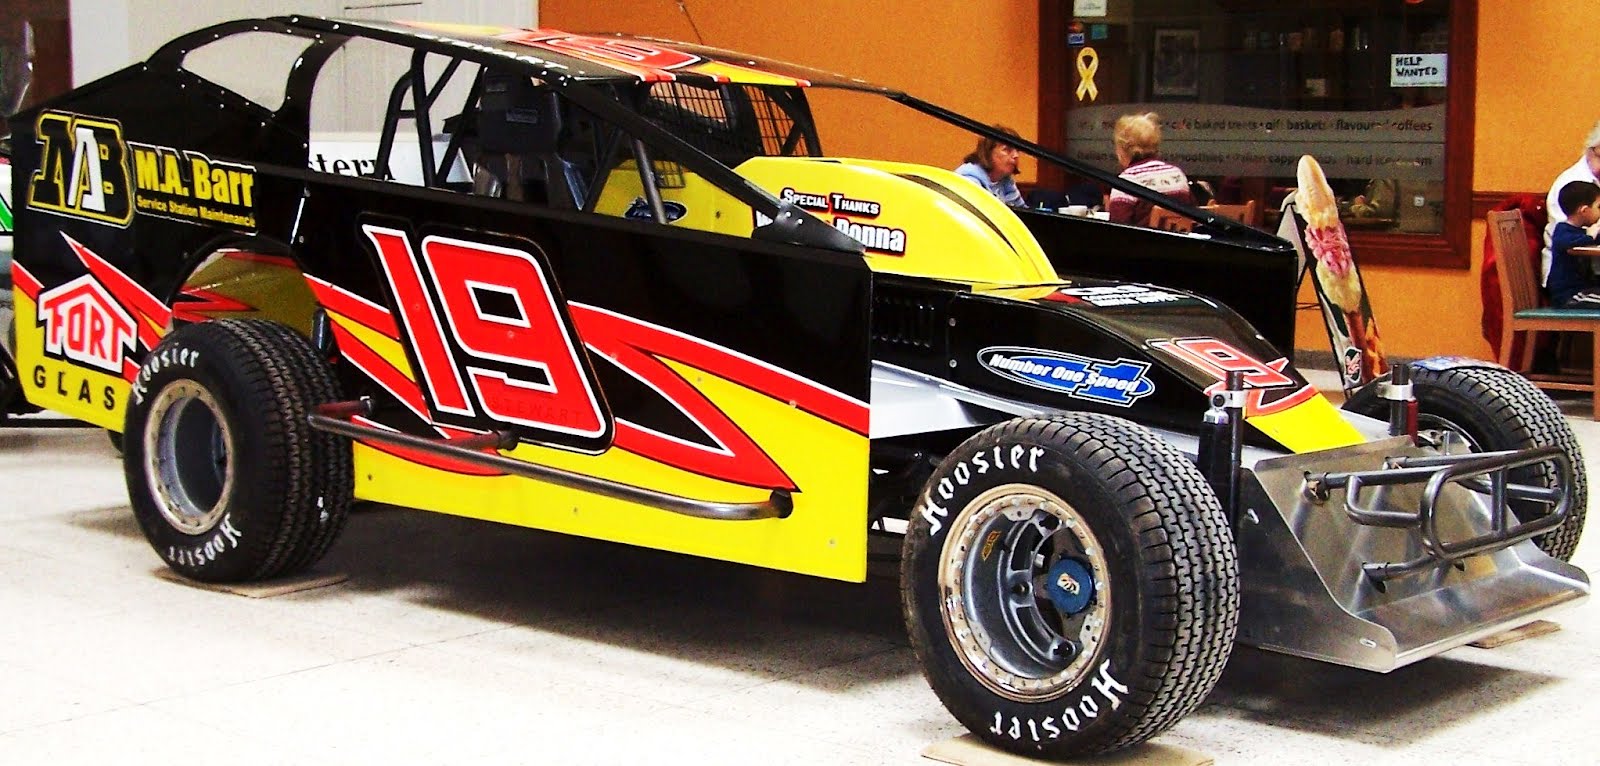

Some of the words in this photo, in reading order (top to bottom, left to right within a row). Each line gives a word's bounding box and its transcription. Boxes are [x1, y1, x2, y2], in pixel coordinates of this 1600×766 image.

[1395, 56, 1423, 67] HELP
[1395, 66, 1438, 77] WANTED
[135, 149, 190, 197] M.A.
[191, 158, 254, 207] Barr
[308, 153, 396, 180] ter
[137, 195, 168, 212] Service
[169, 200, 199, 217] Station
[200, 206, 256, 228] Maintenance
[782, 188, 829, 209] SPECIAL
[832, 194, 880, 215] THANKS
[42, 281, 133, 365] FORT
[361, 223, 607, 440] 19
[131, 341, 200, 405] Hoosier
[988, 353, 1049, 377] Number
[1051, 366, 1086, 384] One
[1085, 371, 1142, 393] Speed
[1146, 334, 1296, 389] 19
[33, 364, 116, 411] GLAS
[487, 396, 585, 427] STEWART
[920, 443, 1046, 537] Hoosier
[168, 511, 243, 567] Hoosier
[989, 658, 1130, 742] Hoosier
